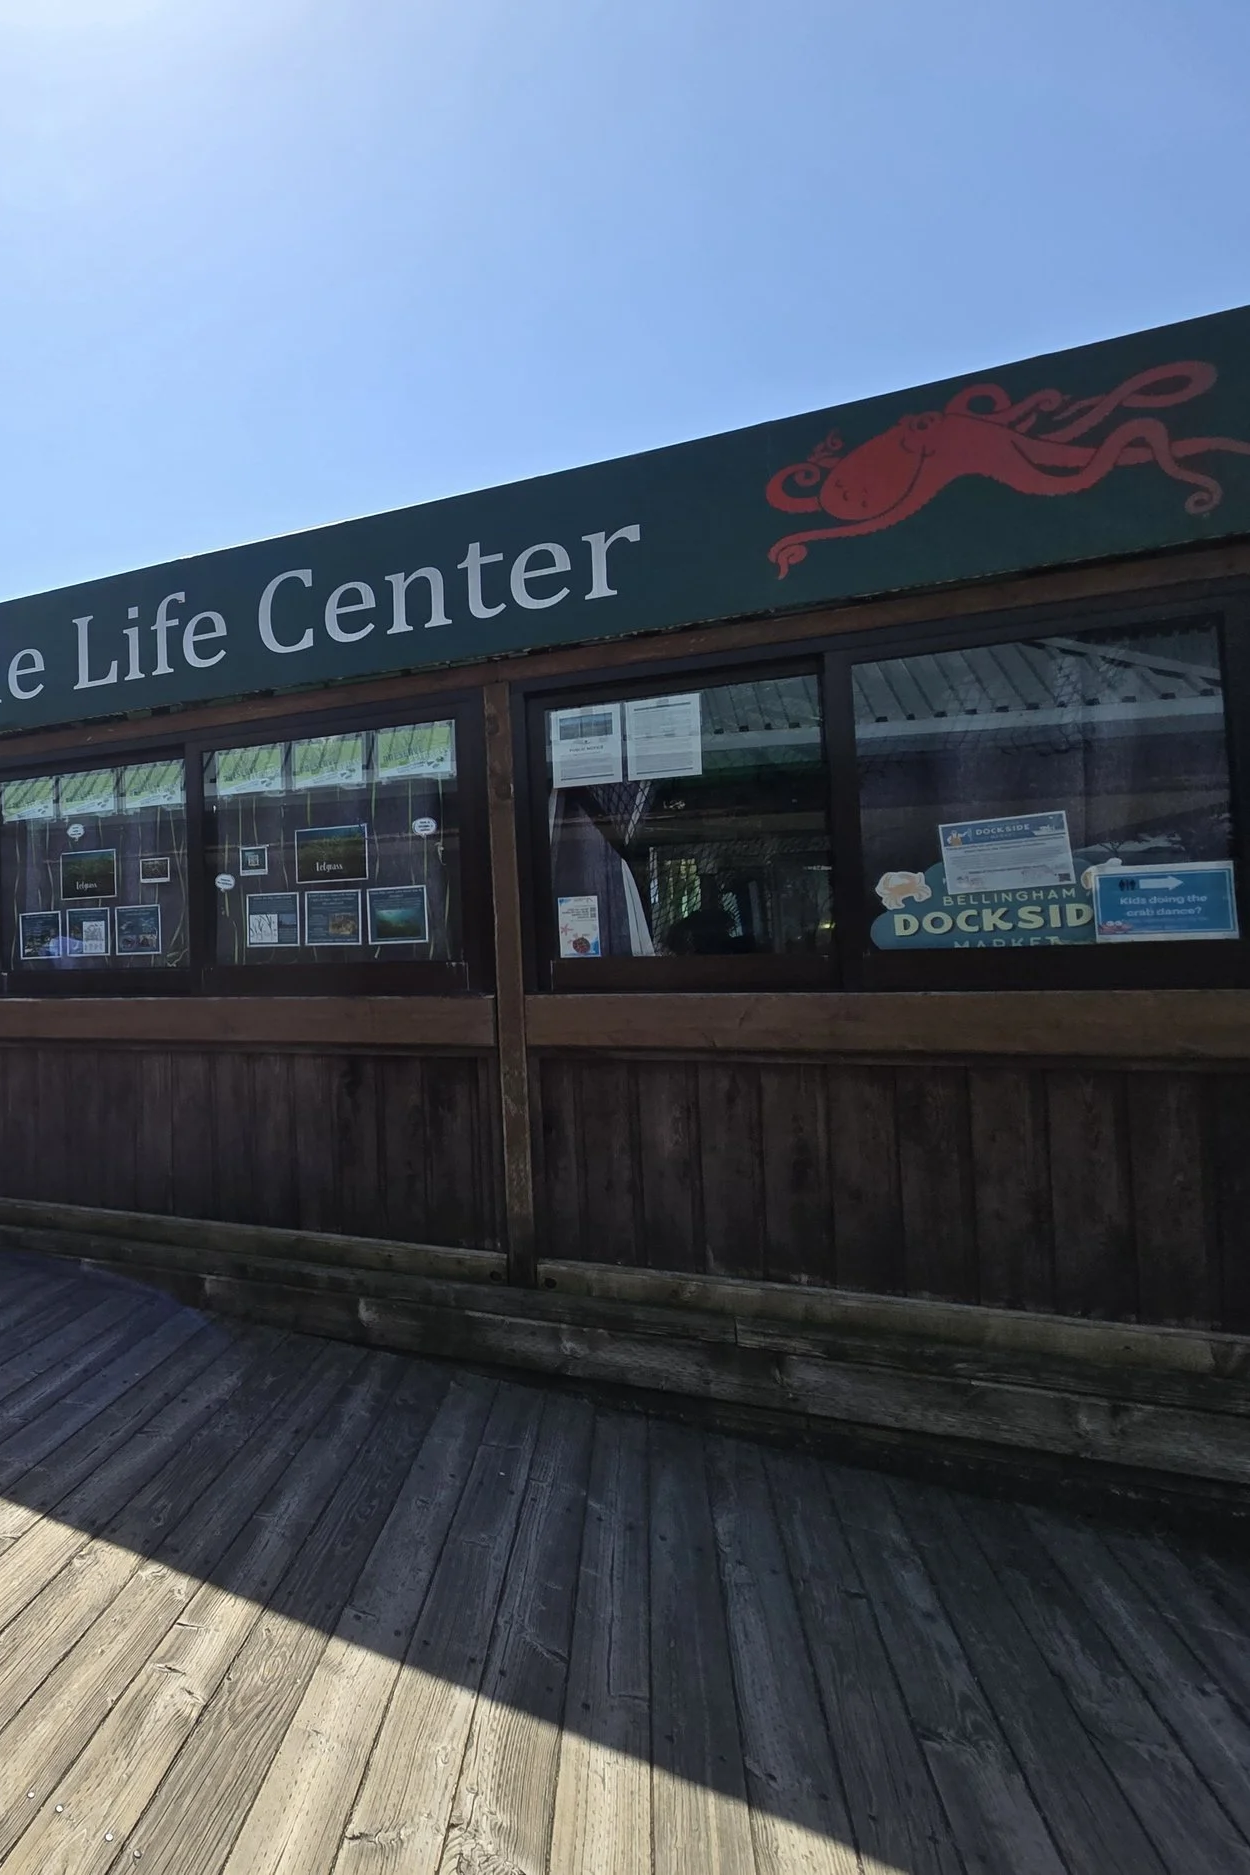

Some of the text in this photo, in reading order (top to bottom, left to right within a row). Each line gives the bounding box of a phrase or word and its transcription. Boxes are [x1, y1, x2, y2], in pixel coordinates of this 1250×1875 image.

[72, 591, 228, 691] Life
[257, 523, 642, 655] Center
[975, 823, 1030, 836] DOCKSIDE
[942, 887, 1076, 906] BELLINGHAM
[1120, 894, 1208, 905] Kids doing the
[893, 902, 1094, 936] DOCKSID
[1126, 906, 1202, 918] crab dance?
